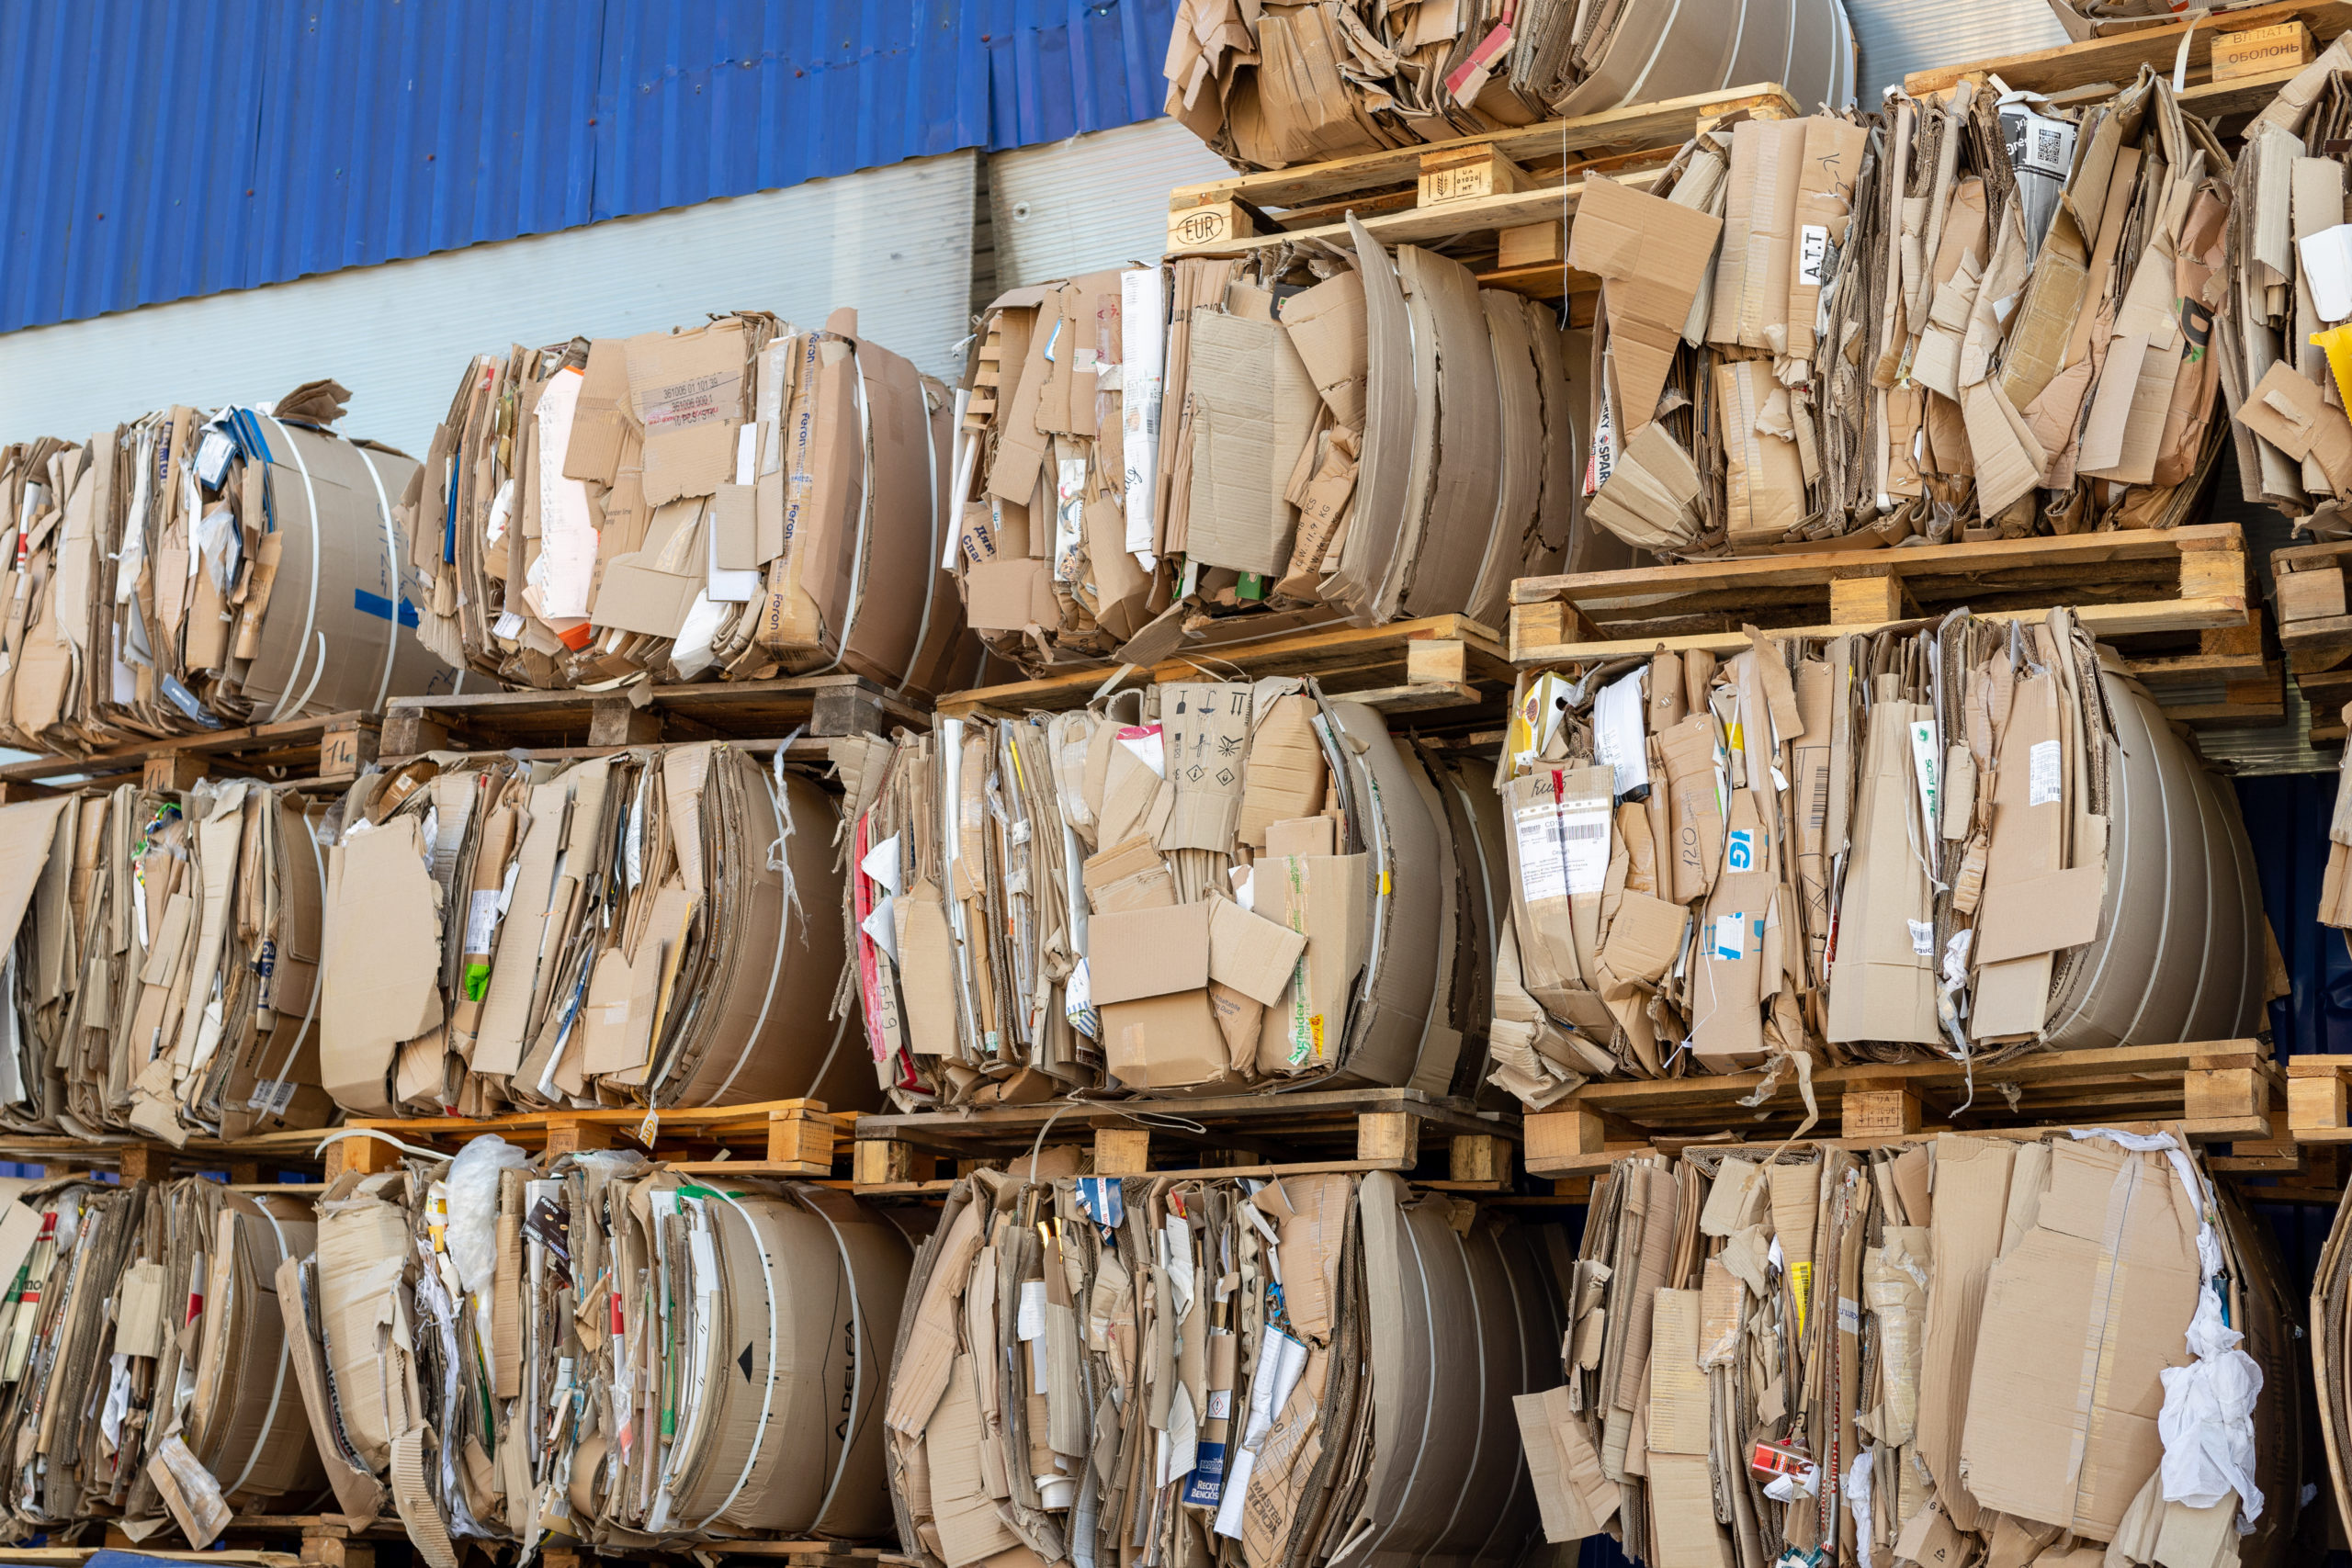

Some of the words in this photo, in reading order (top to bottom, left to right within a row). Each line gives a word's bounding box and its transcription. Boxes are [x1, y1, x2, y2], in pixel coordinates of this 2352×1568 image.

[2228, 42, 2300, 64] ОБОЛОНЬ
[1456, 175, 1480, 185] 01020
[1462, 184, 1474, 192] HT
[1185, 218, 1215, 241] EUR
[1804, 231, 1823, 279] A.T.T
[806, 332, 820, 364] Feron
[663, 384, 687, 400] 361006
[687, 383, 695, 393] 01
[696, 379, 708, 392] 101
[709, 377, 718, 388] 39
[798, 412, 810, 447] Feron
[1304, 499, 1317, 515] PCS
[1318, 504, 1330, 519] KG
[785, 503, 799, 540] Feron
[770, 592, 784, 631] Feron
[1681, 827, 1701, 869] 120
[1251, 1480, 1283, 1529] MASTER
